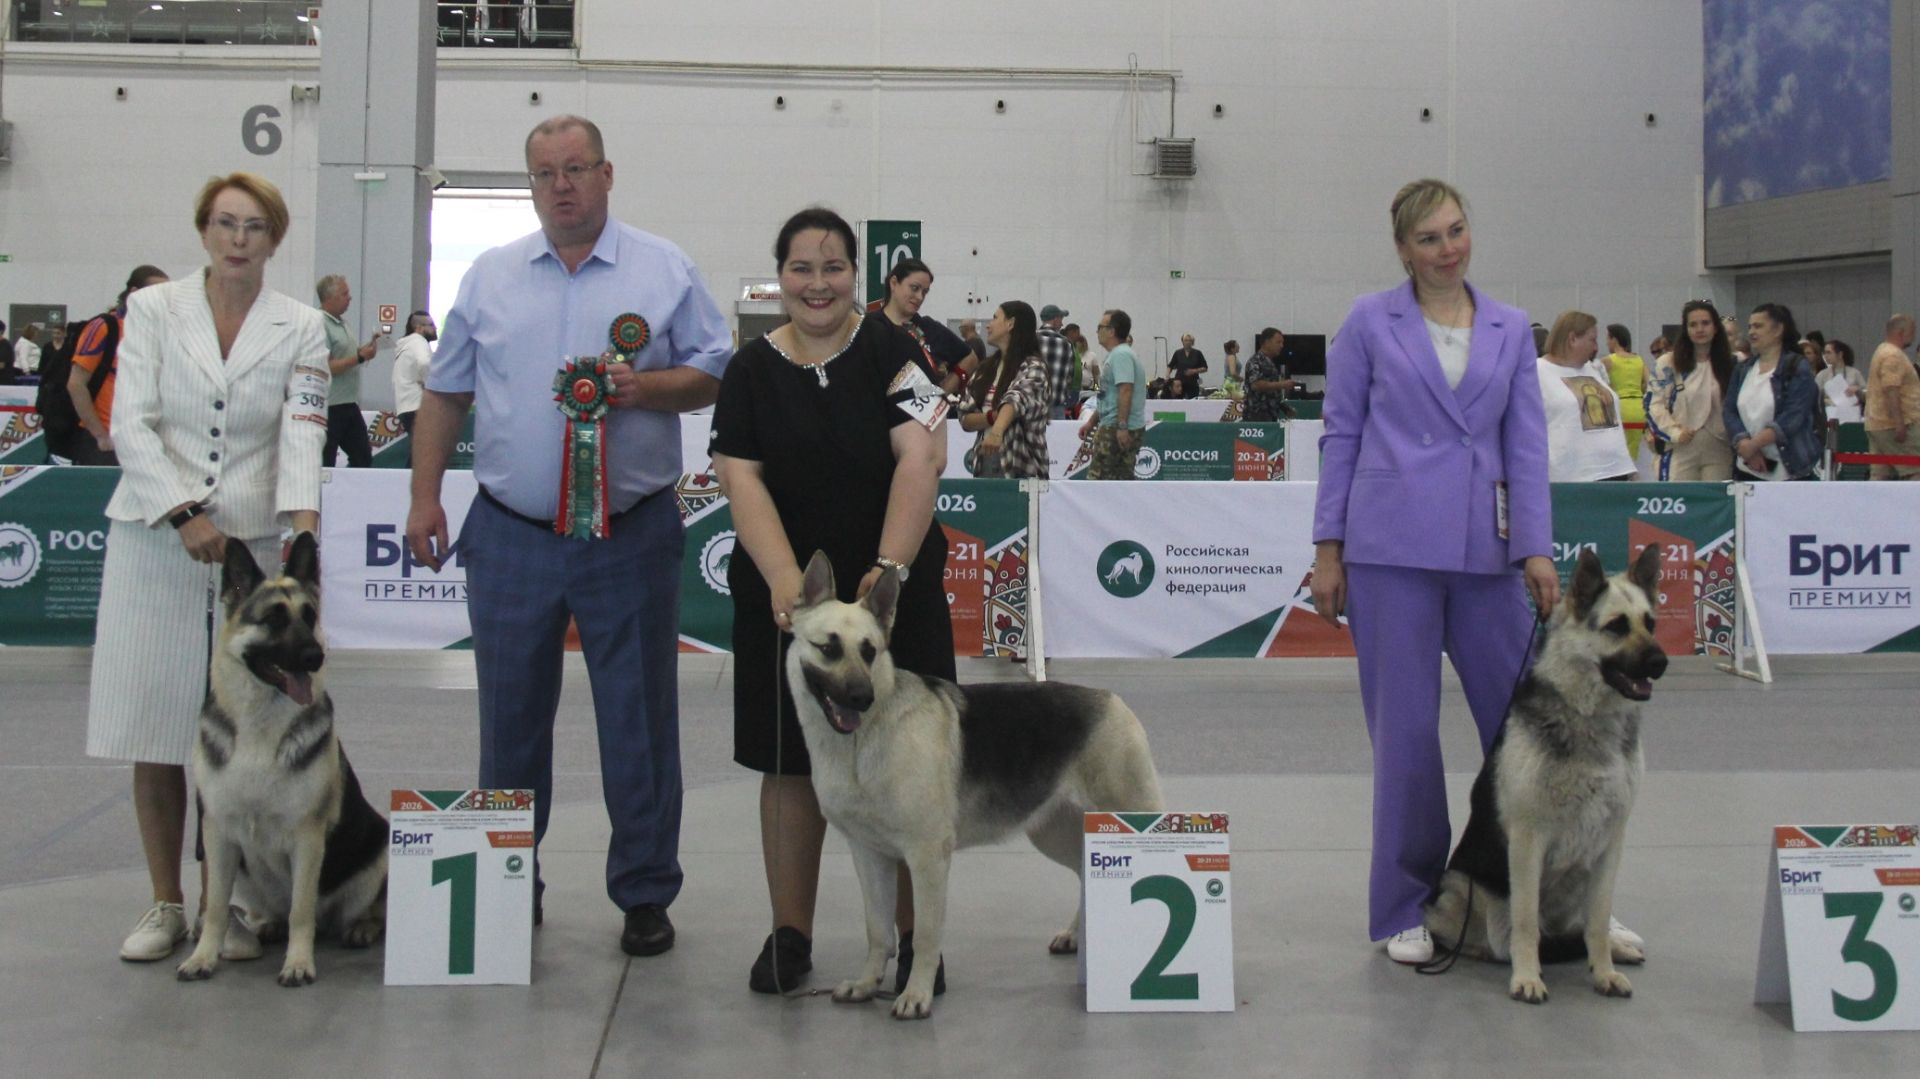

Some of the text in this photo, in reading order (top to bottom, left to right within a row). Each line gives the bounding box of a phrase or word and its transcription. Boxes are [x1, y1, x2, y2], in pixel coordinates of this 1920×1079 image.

[242, 105, 282, 156] 6
[910, 395, 935, 413] 30
[1239, 428, 1265, 438] 2026
[1164, 450, 1219, 461] РОССИЯ
[1237, 452, 1265, 462] 20-21
[934, 494, 977, 512] 026
[1637, 497, 1687, 515] 2026
[49, 530, 105, 551] РОС
[948, 543, 978, 561] -21
[1166, 544, 1249, 557] Российская
[1789, 534, 1911, 586] Брит
[1165, 565, 1283, 575] кинологическая
[365, 583, 468, 600] ПРЕМИУ
[1165, 580, 1247, 597] федерация
[1789, 591, 1911, 606] ПРЕМИУМ
[401, 802, 423, 811] 2026
[1098, 823, 1120, 832] 2026
[392, 830, 434, 847] Брит
[1784, 838, 1807, 847] 2026
[1090, 852, 1133, 870] Брит
[1780, 868, 1822, 887] Брит
[432, 851, 478, 975] 1
[1130, 874, 1200, 1000] 2
[1823, 891, 1898, 1022] 3
